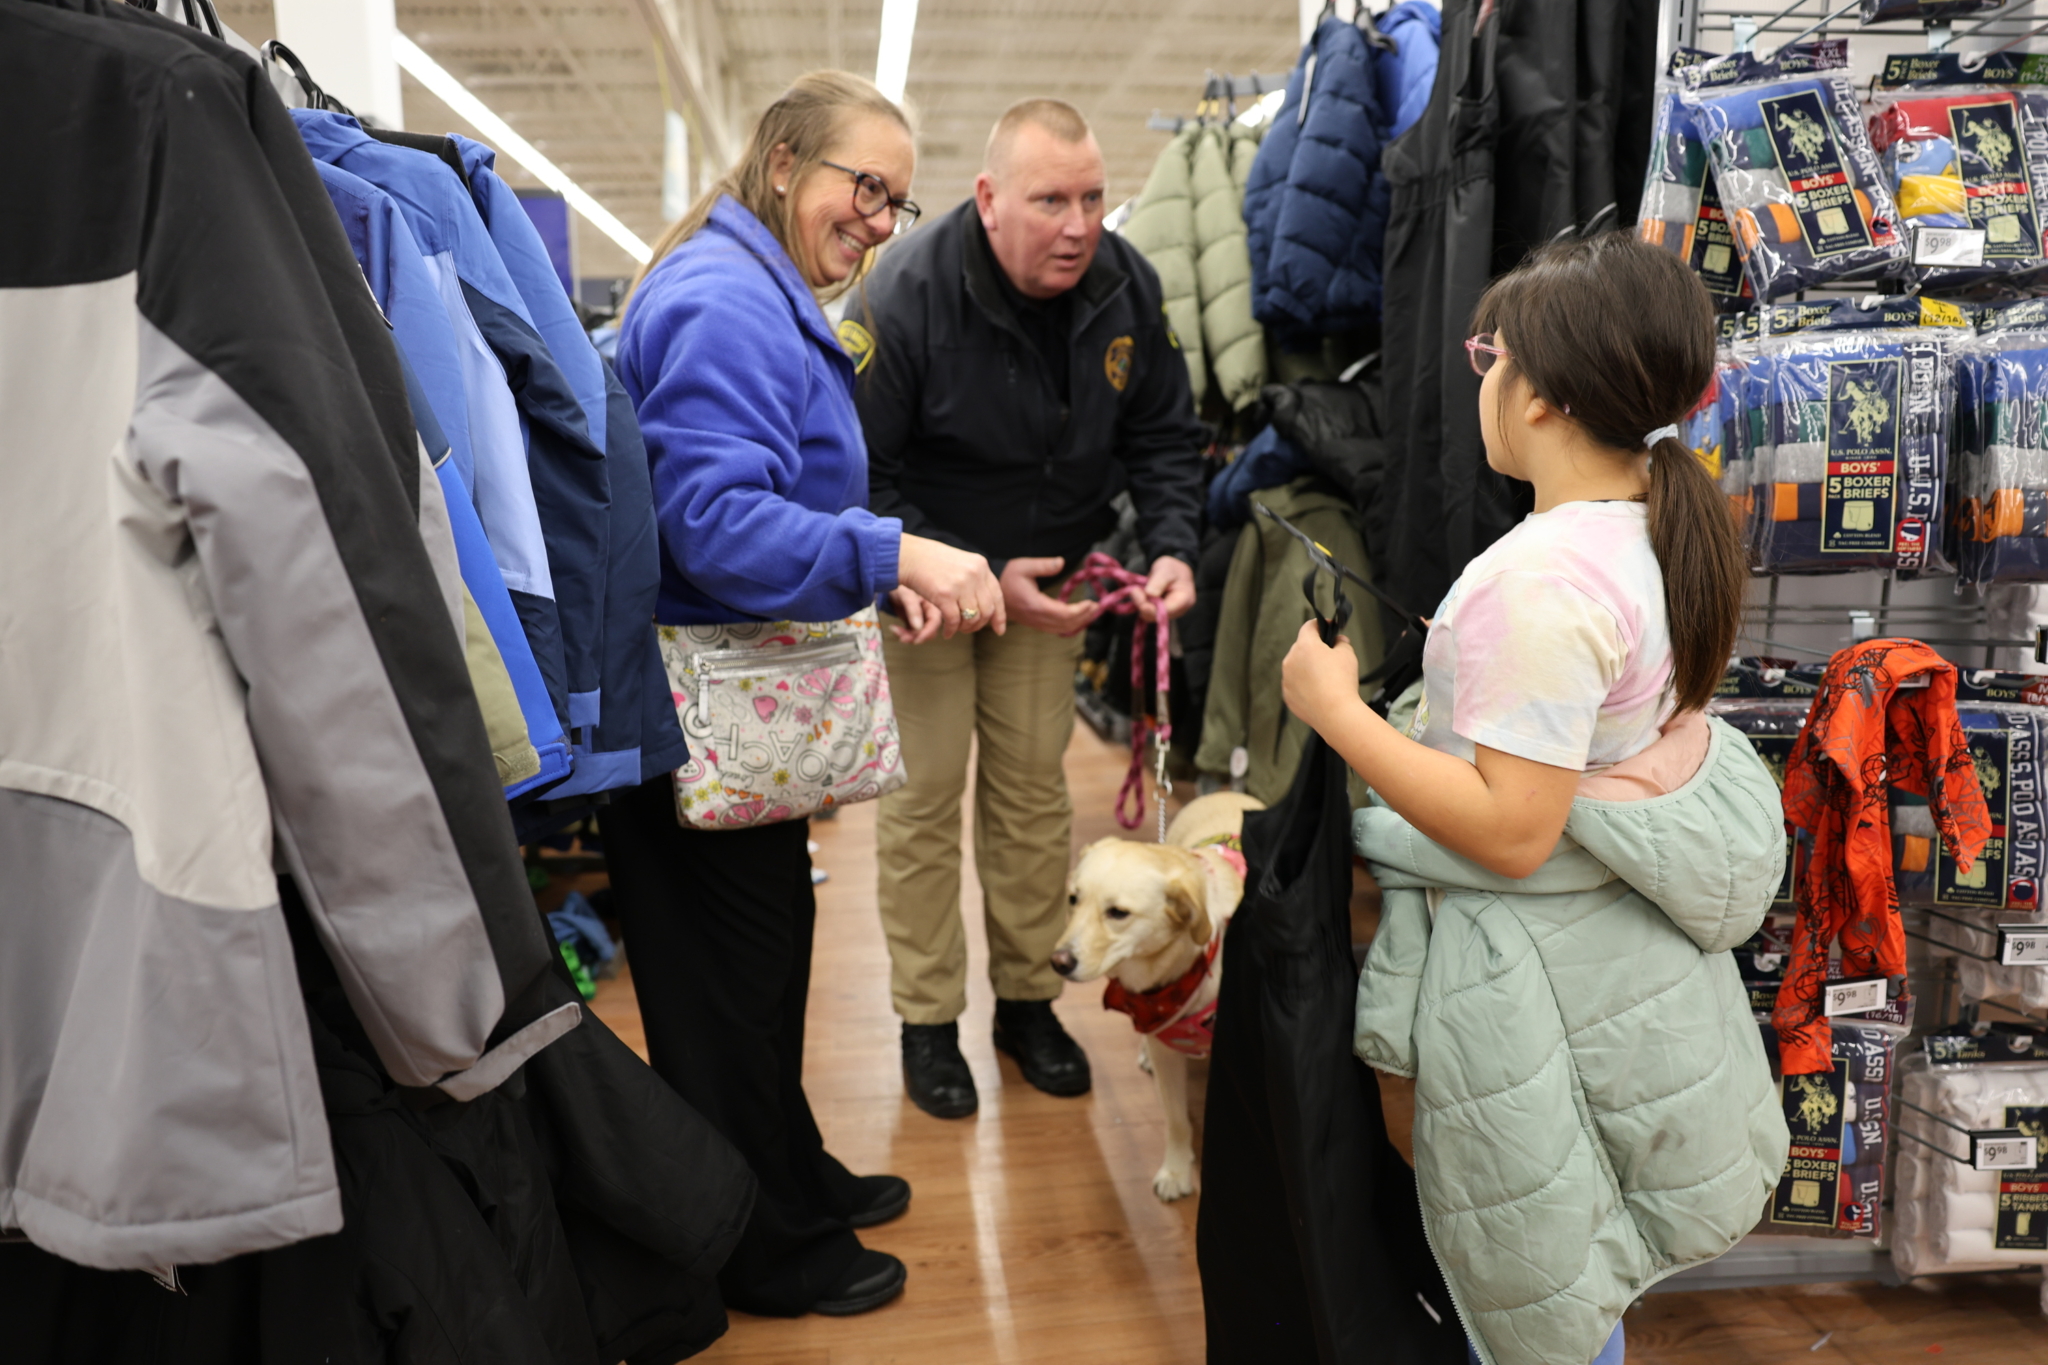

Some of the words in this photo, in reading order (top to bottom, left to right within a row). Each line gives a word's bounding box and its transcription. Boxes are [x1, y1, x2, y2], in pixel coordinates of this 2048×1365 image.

[1886, 59, 1902, 80] 5
[1909, 57, 1941, 69] Boxer
[1906, 68, 1939, 81] Briefs
[1801, 174, 1835, 189] BOYS'
[1807, 184, 1850, 201] BOXER
[1811, 194, 1852, 212] BRIEFS
[1984, 193, 2029, 206] BOXER
[1970, 198, 1985, 215] 5
[1697, 219, 1709, 237] 5
[1798, 304, 1833, 316] Boxer
[1773, 308, 1788, 329] 5
[1797, 315, 1832, 328] Briefs
[1721, 319, 1735, 338] 5
[1745, 316, 1759, 335] 5
[1846, 448, 1868, 456] POLO
[1868, 447, 1893, 455] ASSN.
[1840, 462, 1881, 474] BOYS'
[1829, 476, 1842, 494] 5
[1843, 476, 1892, 488] BOXER
[1843, 488, 1889, 499] BRIEFS
[1933, 1041, 1947, 1060] 5
[1791, 1146, 1828, 1158] BOYS'
[1793, 1159, 1837, 1172] BOXER
[1792, 1169, 1835, 1181] BRIEFS
[2000, 1193, 2012, 1207] 5
[2012, 1202, 2048, 1212] TANKS
